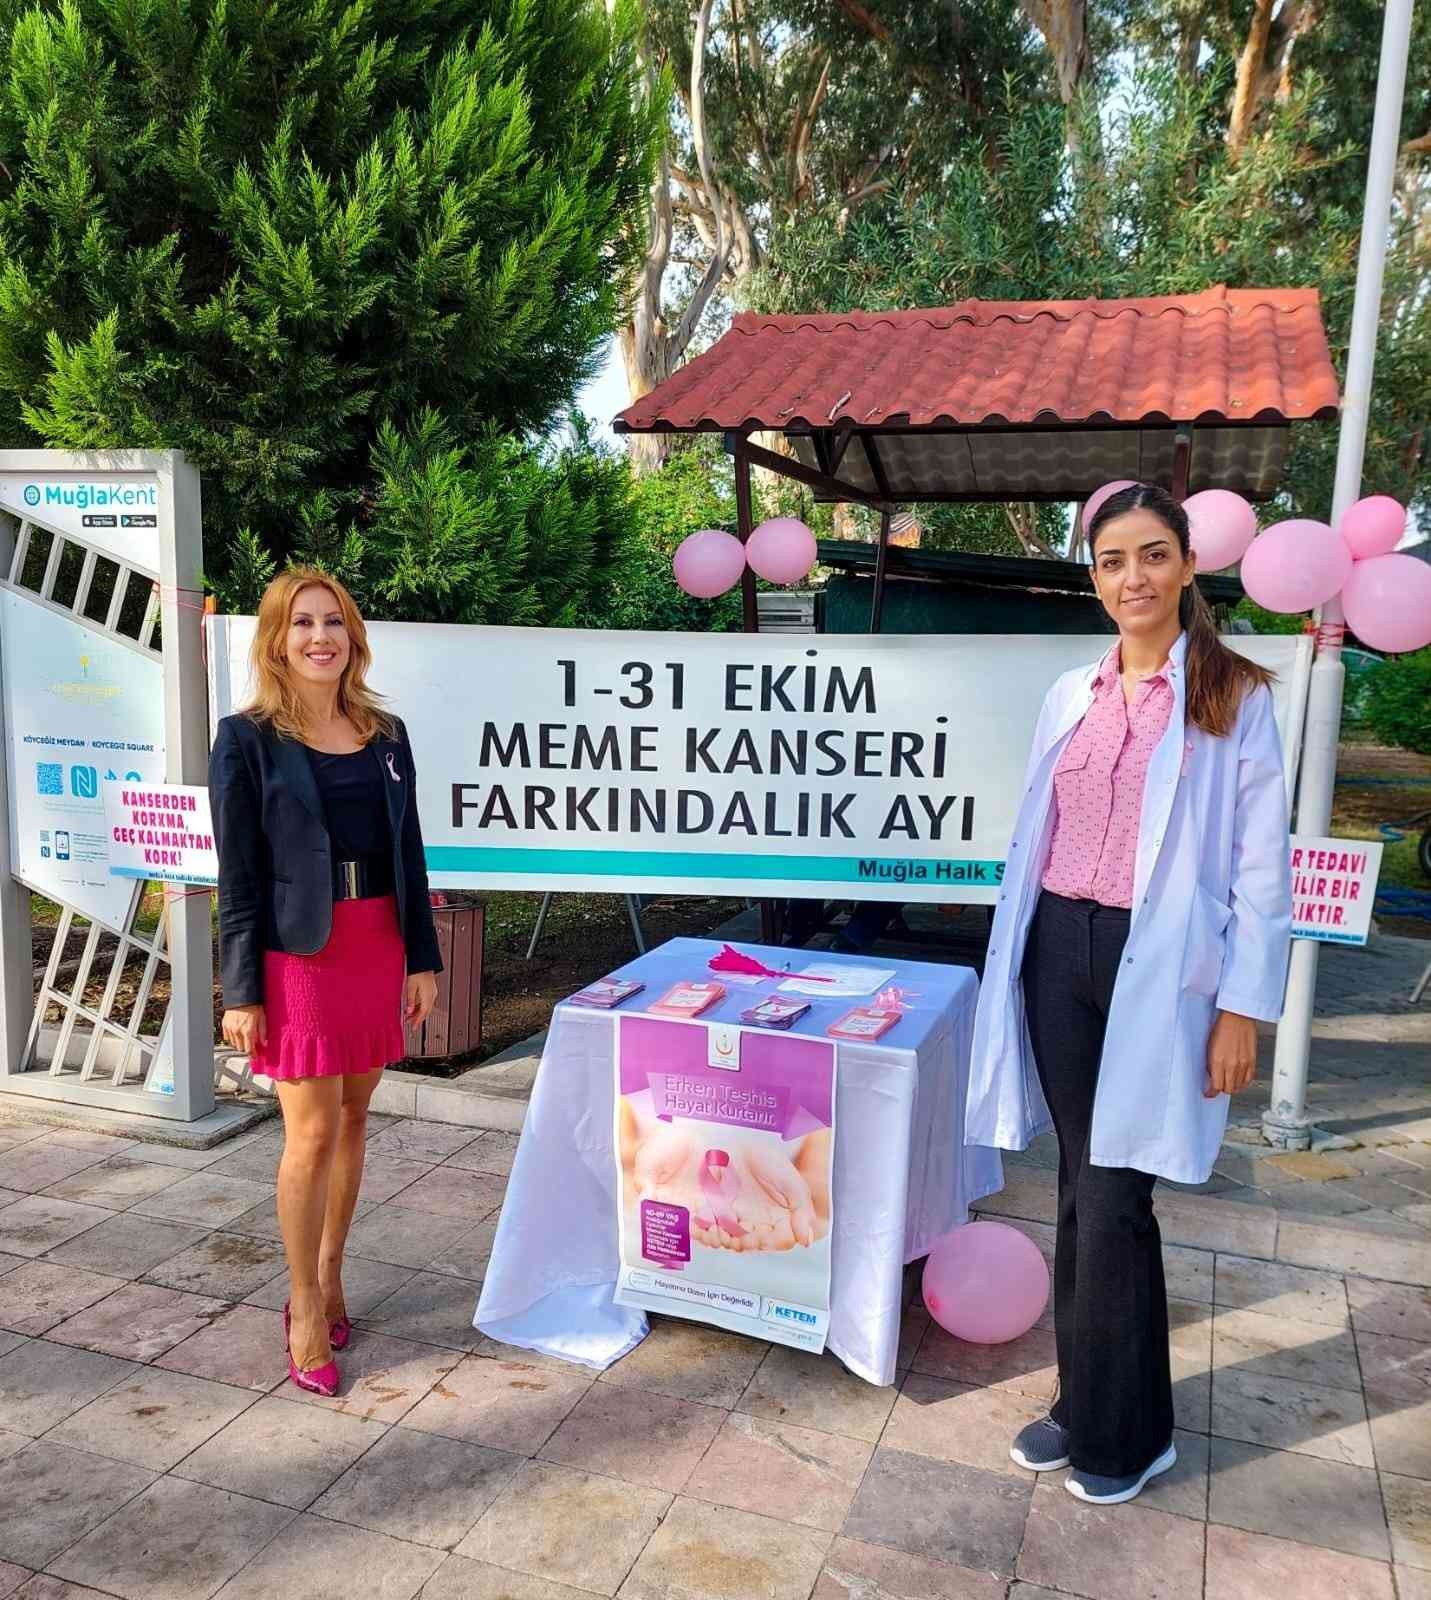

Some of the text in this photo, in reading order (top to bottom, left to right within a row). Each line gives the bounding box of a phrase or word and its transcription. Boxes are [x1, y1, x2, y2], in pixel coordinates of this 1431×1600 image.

[45, 484, 156, 509] MuğlaKent
[557, 649, 877, 713] 1-31 EKİM
[479, 716, 948, 778] MEME KANSERİ
[122, 791, 196, 811] KANSERDEN
[451, 783, 975, 841] FARKINDALIK AYI
[132, 811, 188, 832] KORKMA,
[113, 827, 212, 851] GEÇ KALMAKTAN
[145, 848, 182, 866] KORK!
[1308, 850, 1367, 875] TEDAVİ
[858, 861, 927, 882] Muğla
[935, 863, 986, 880] Halk
[1293, 871, 1360, 900] İLİR BİR
[665, 1076, 715, 1098] Erken
[665, 1094, 712, 1116] Hayat
[775, 1305, 817, 1325] KETEM
